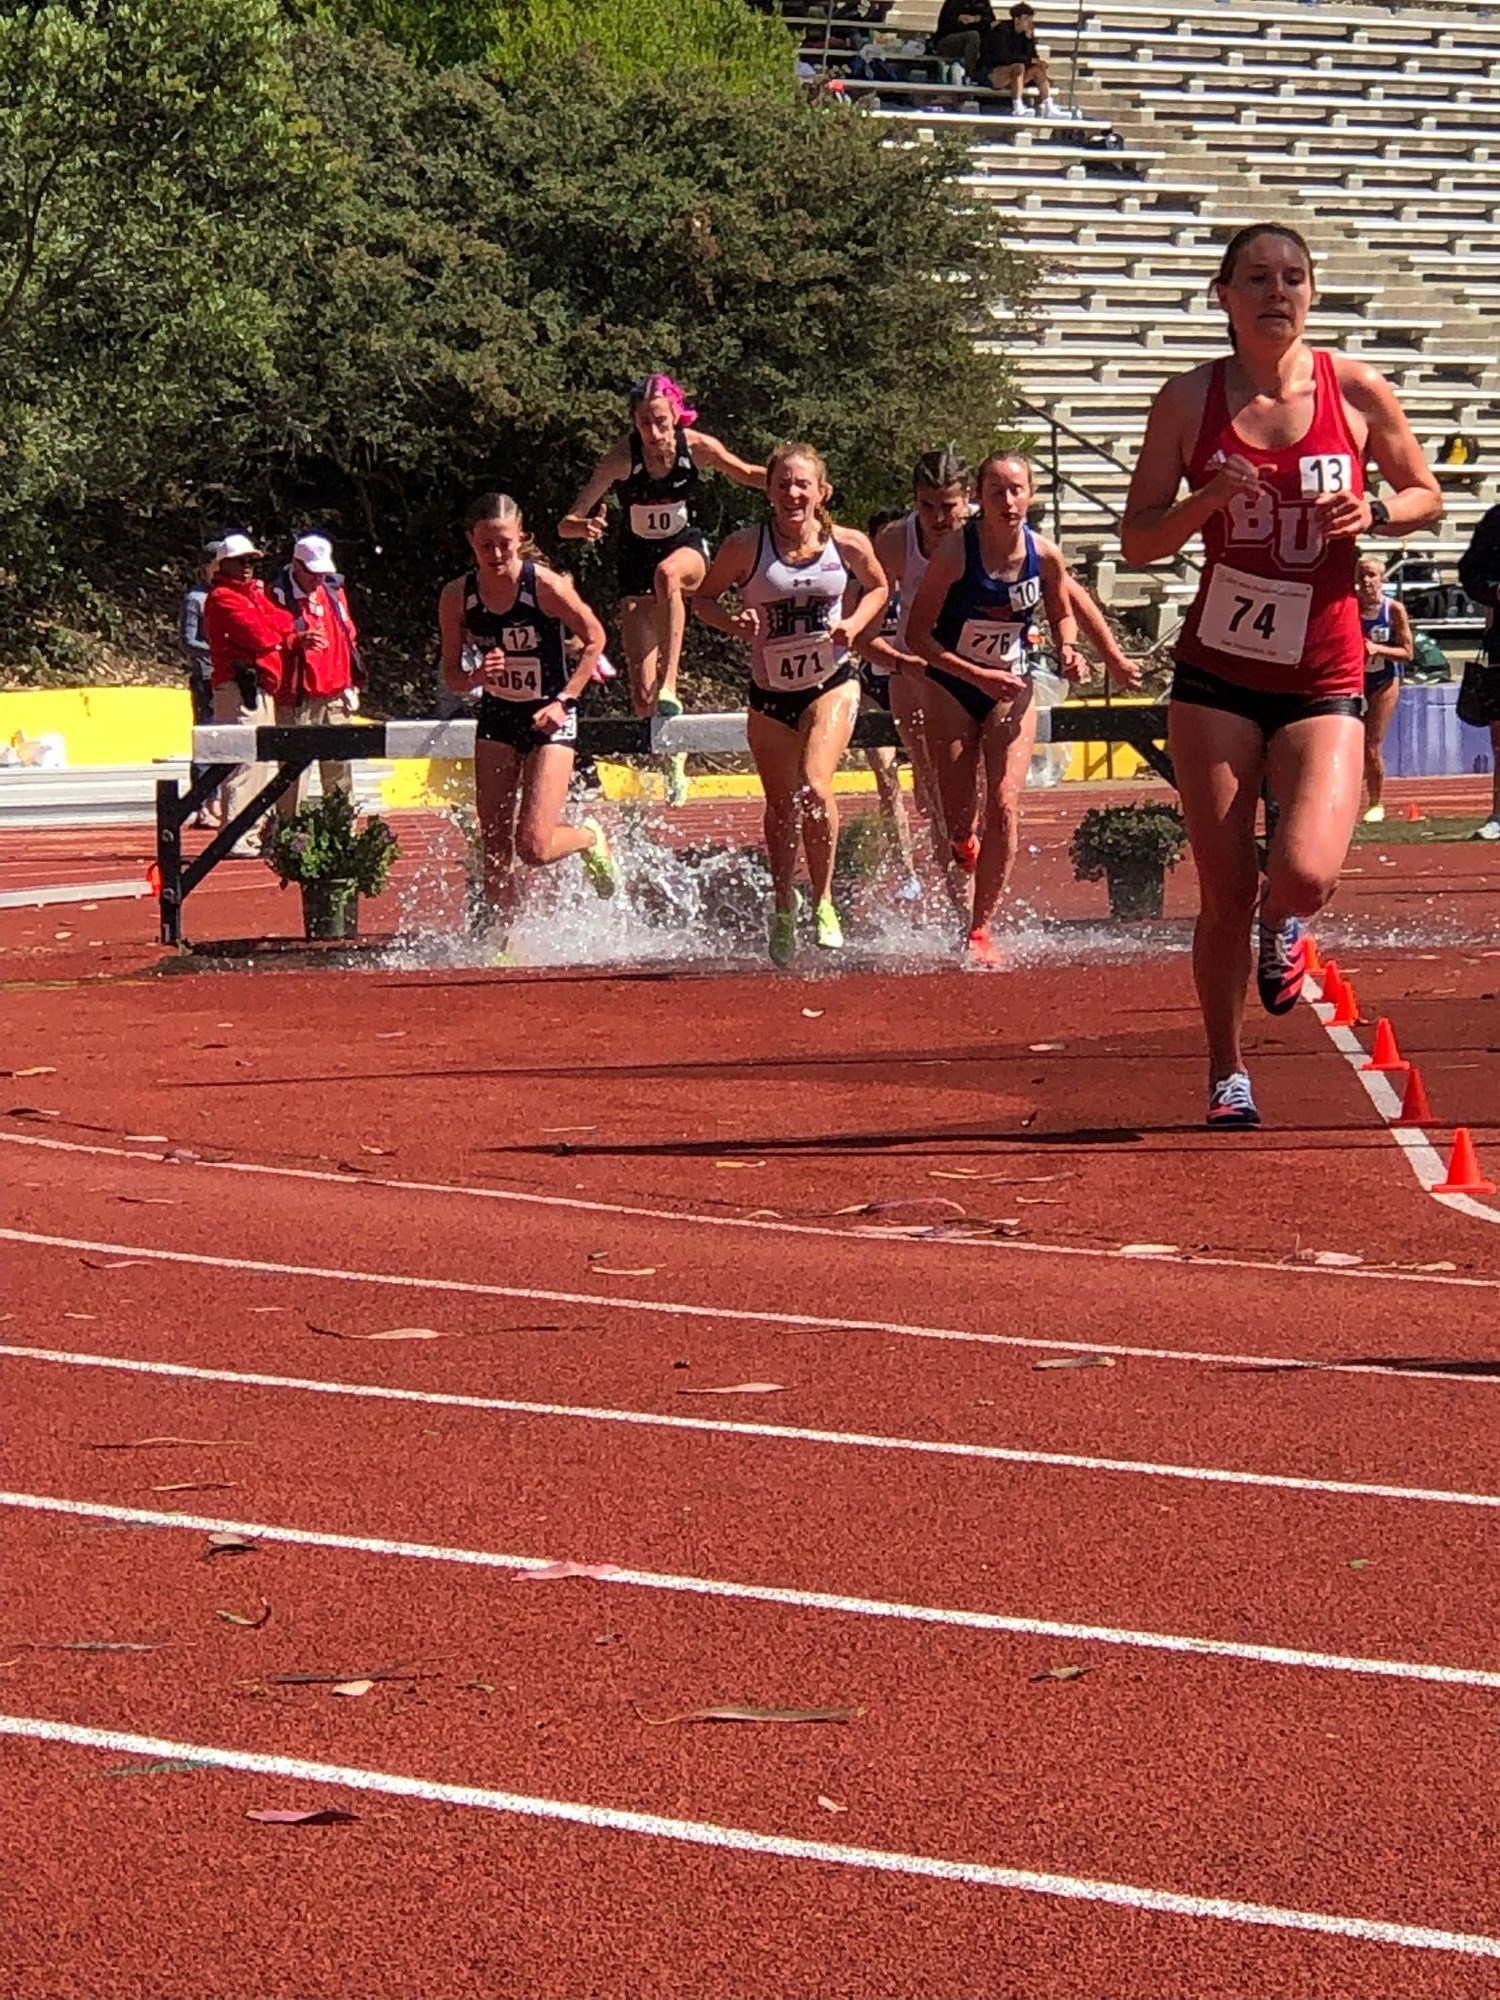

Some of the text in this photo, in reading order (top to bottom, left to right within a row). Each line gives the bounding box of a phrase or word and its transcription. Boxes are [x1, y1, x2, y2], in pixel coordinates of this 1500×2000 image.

[1309, 458, 1343, 494] 13
[647, 512, 671, 530] 10
[1225, 480, 1329, 572] BU
[1015, 581, 1037, 608] 10
[1228, 595, 1276, 640] 74
[508, 628, 533, 650] 12
[779, 651, 825, 680] 471
[489, 670, 538, 691] 064
